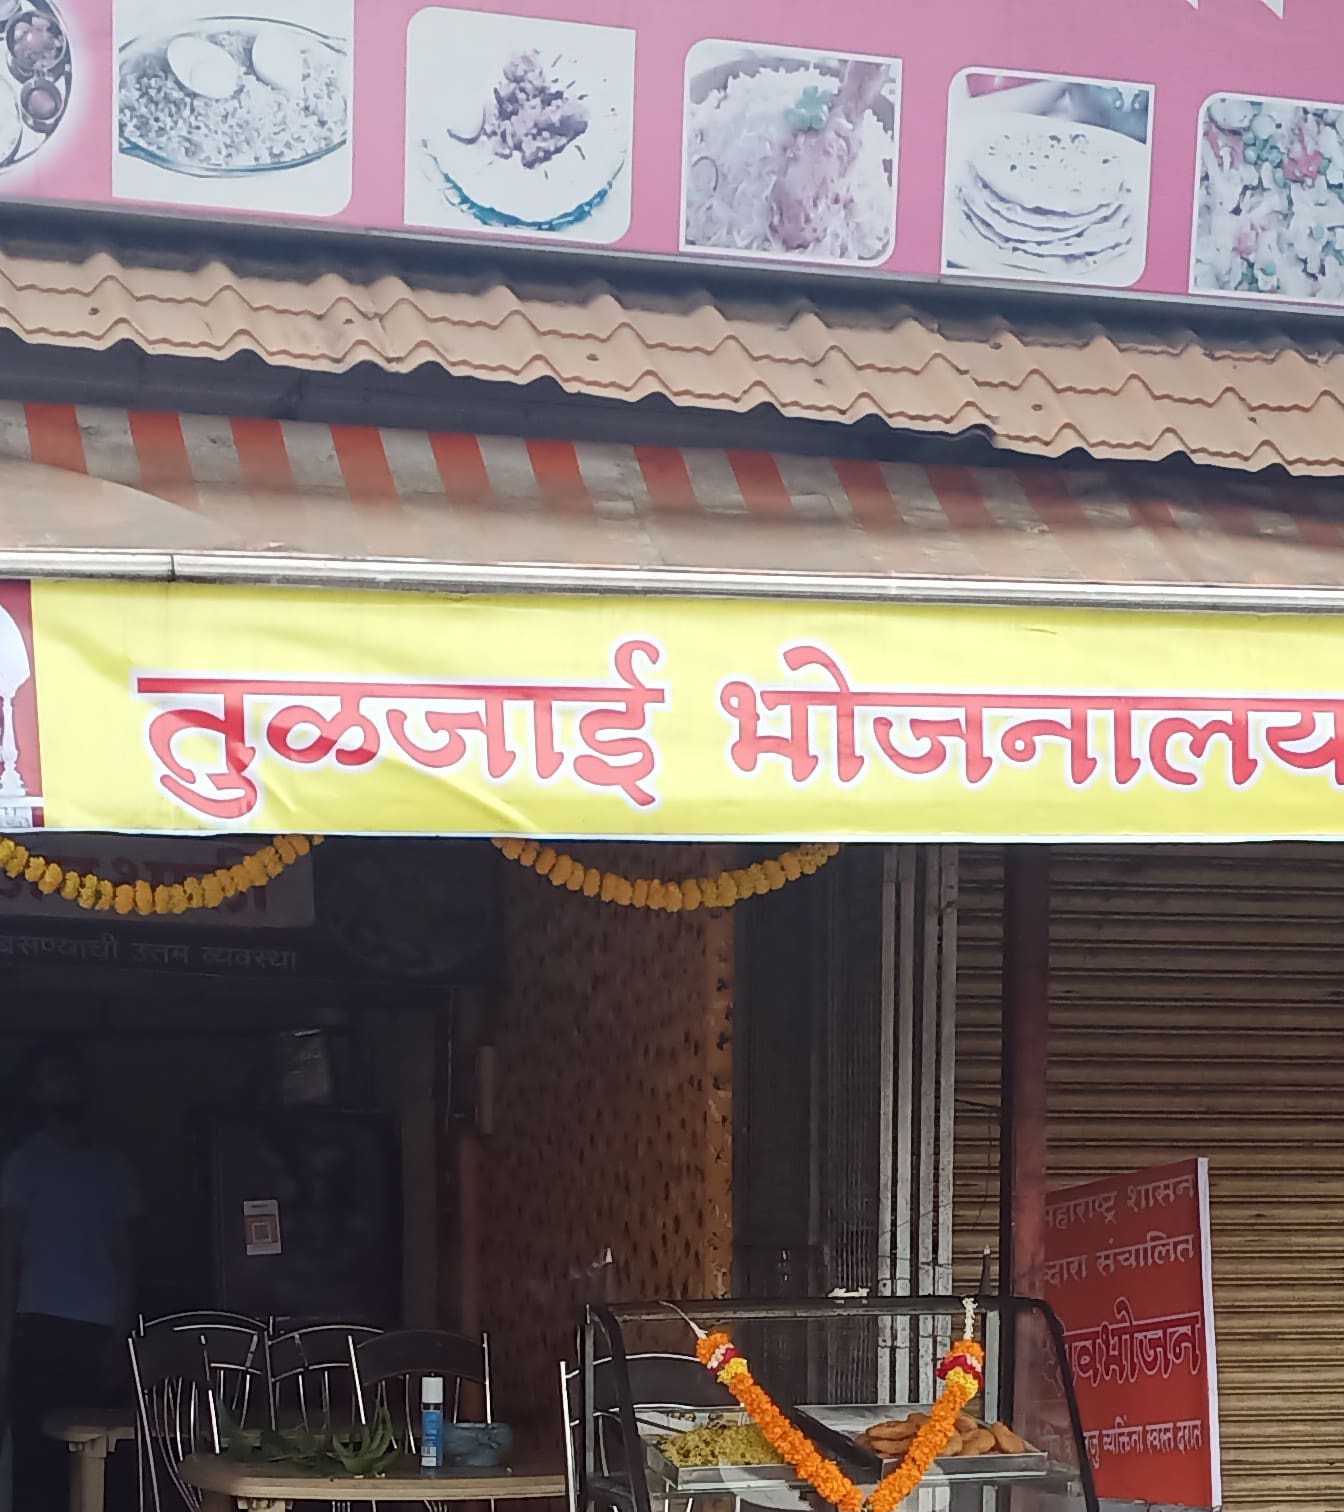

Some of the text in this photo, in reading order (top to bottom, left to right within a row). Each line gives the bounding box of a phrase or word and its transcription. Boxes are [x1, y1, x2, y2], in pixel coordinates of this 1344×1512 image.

[136, 638, 667, 820] तुळजाई
[1127, 1174, 1194, 1213] शासन
[1096, 1230, 1195, 1278] संचालित
